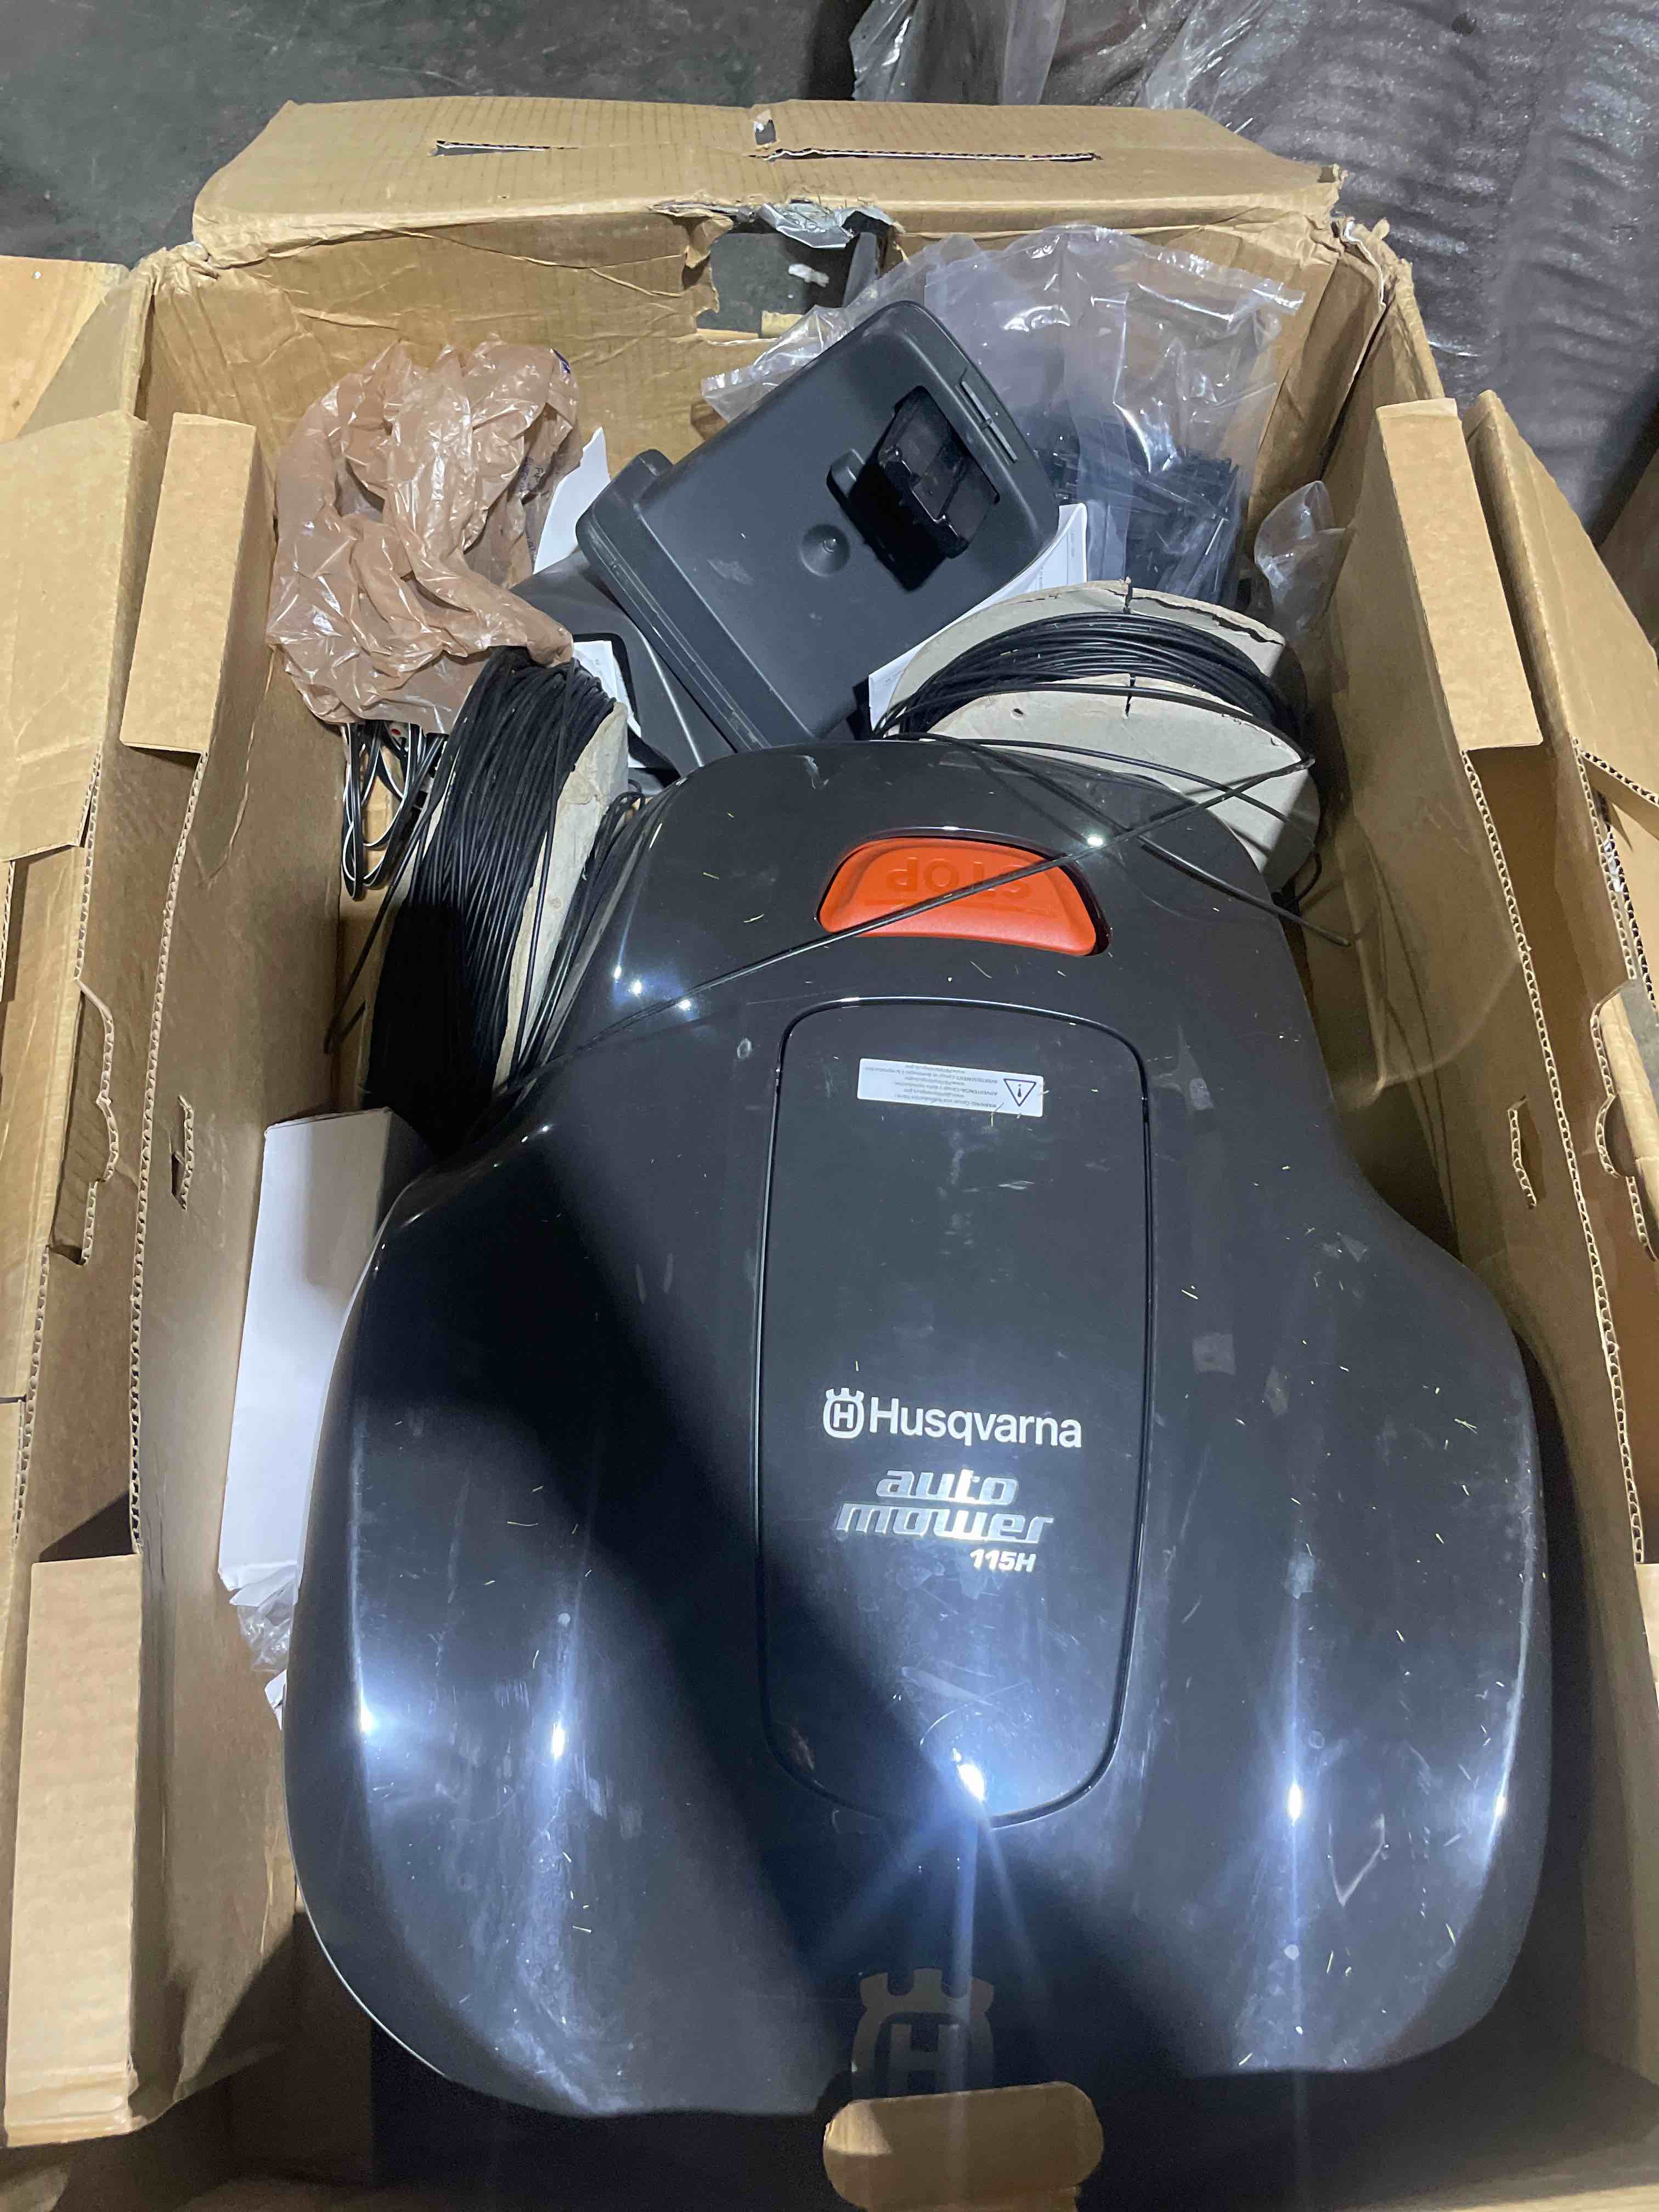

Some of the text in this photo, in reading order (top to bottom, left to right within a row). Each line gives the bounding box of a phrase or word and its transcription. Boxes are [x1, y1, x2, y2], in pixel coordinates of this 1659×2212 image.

[885, 856, 1032, 900] STOP
[869, 1396, 1082, 1448] Husqvarna
[876, 1469, 1019, 1506] auto
[836, 1502, 1054, 1544] mower
[969, 1548, 1037, 1573] 115H
